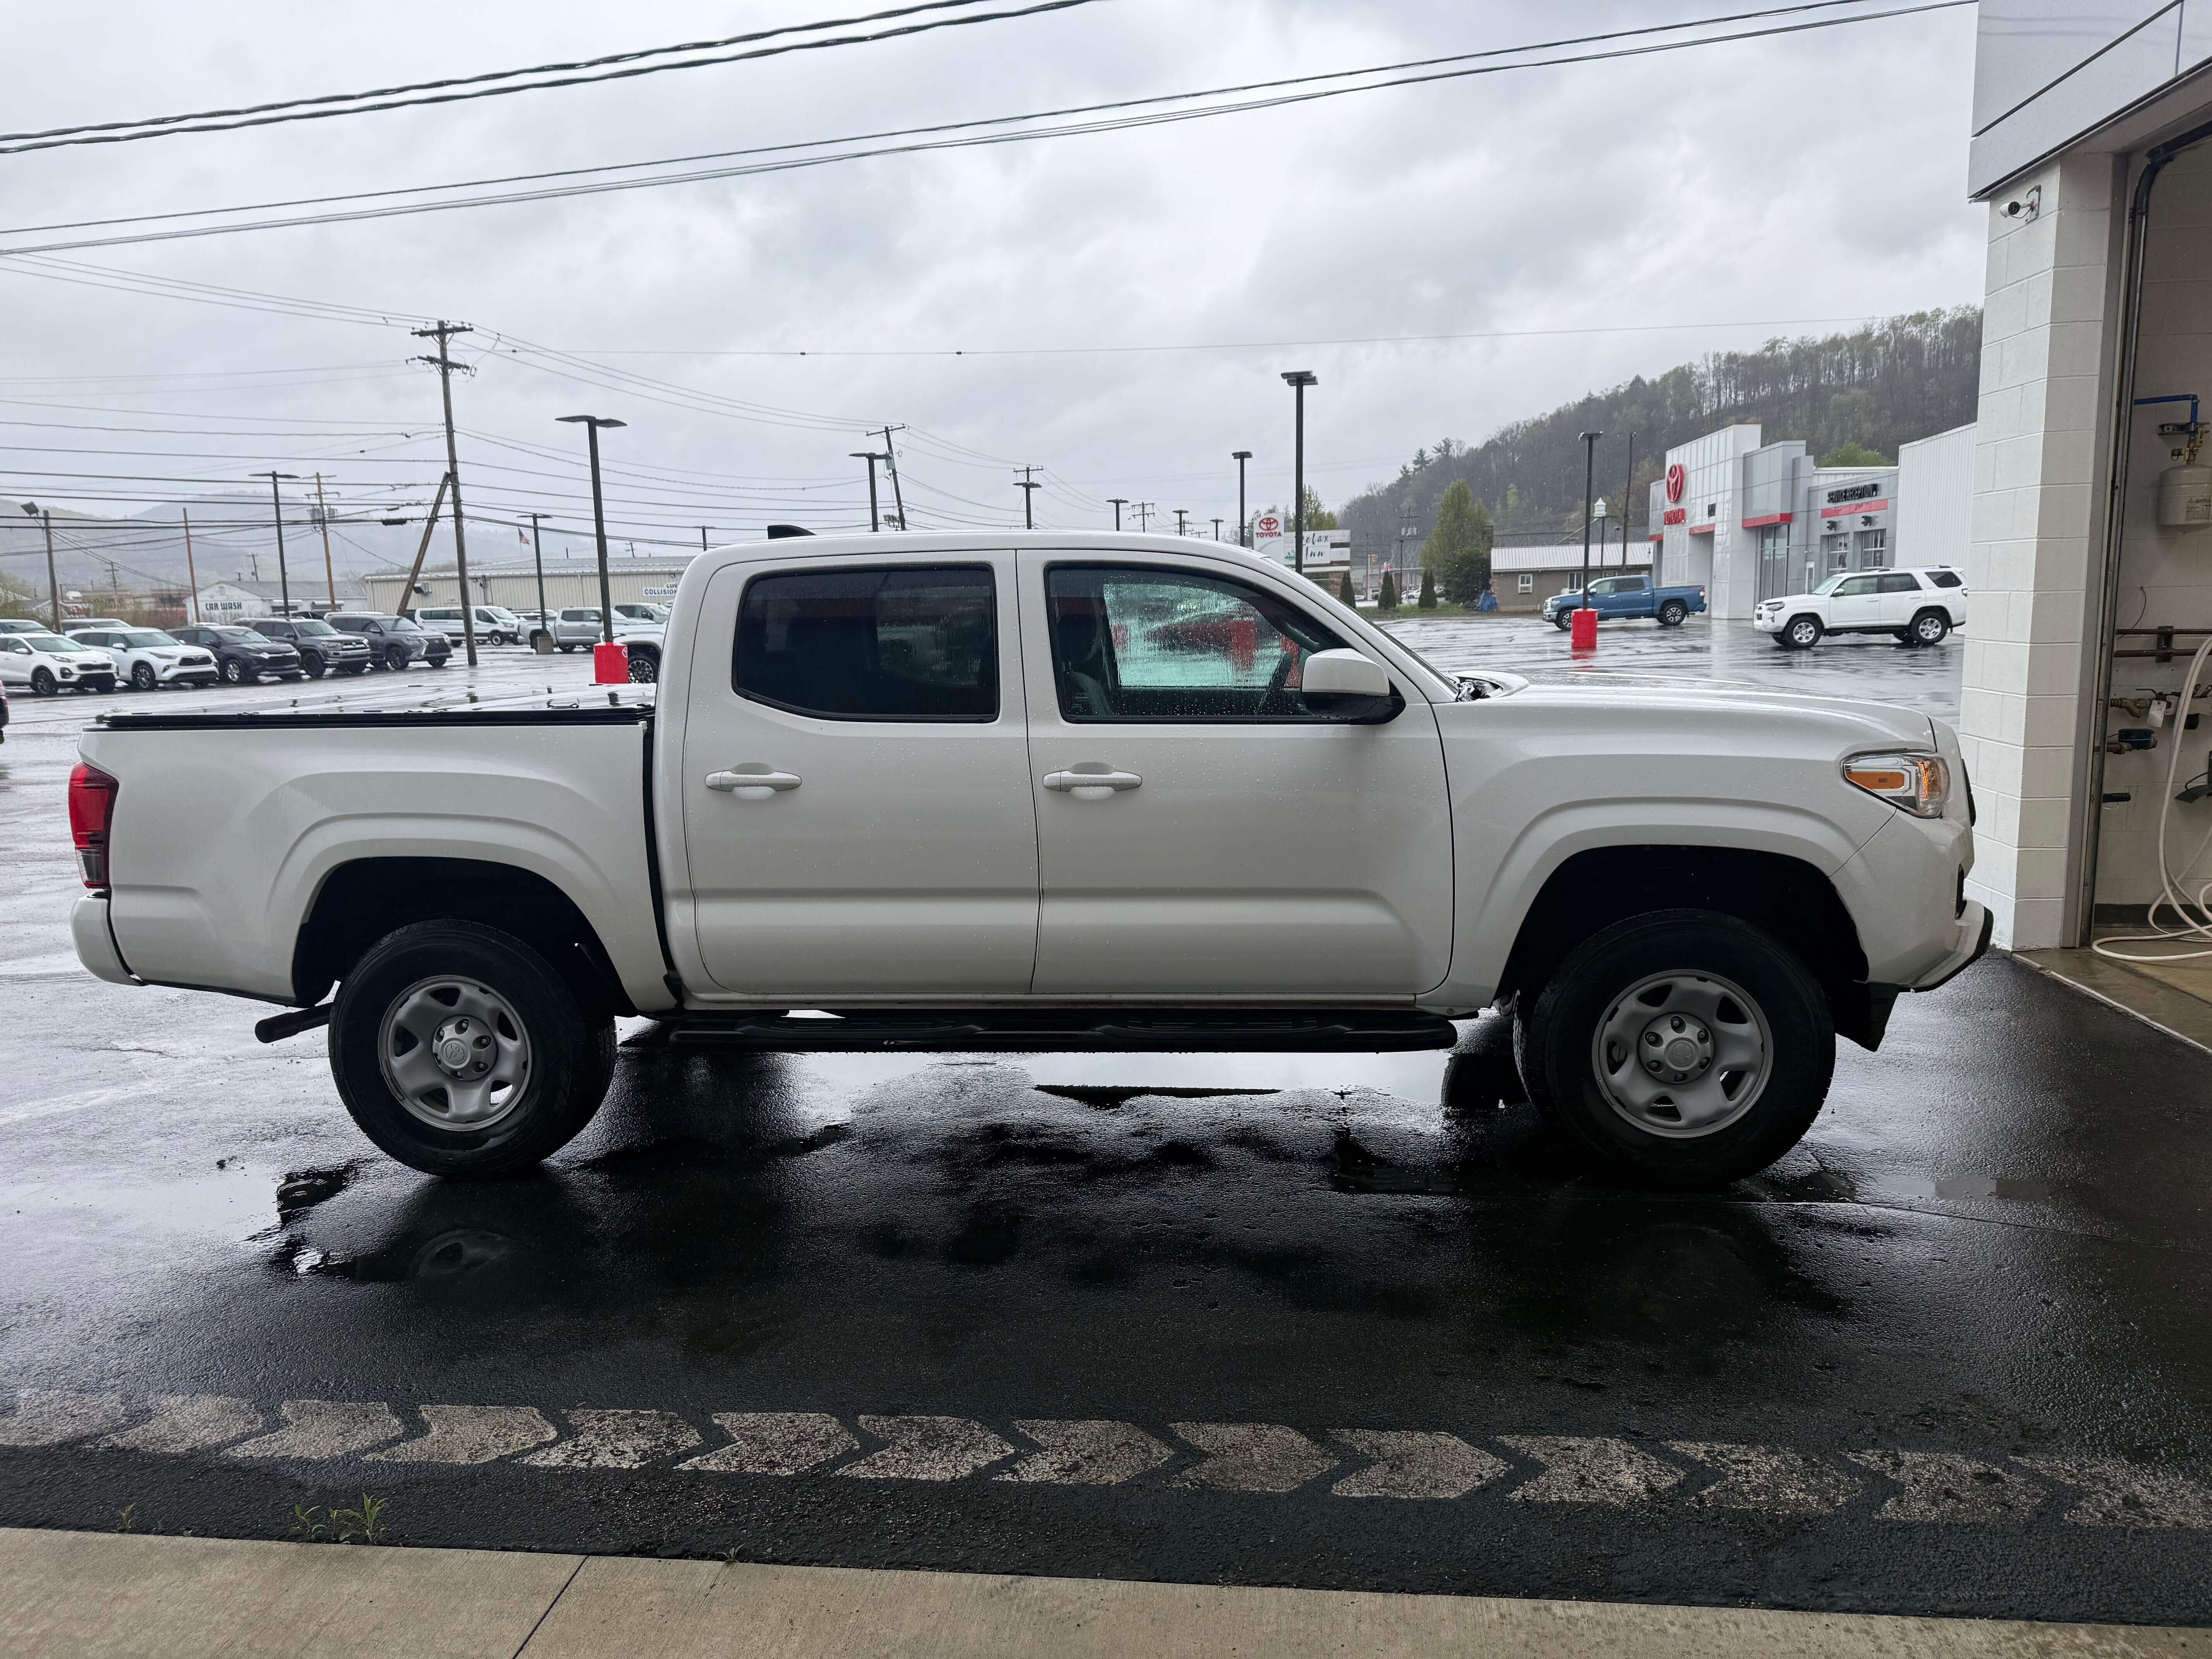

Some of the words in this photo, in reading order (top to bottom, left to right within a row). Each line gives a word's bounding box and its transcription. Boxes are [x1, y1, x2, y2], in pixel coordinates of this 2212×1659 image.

[1827, 489, 1846, 503] SERVICE
[1846, 484, 1877, 501] RECEPTION
[1664, 508, 1685, 525] TOYOTA
[1302, 532, 1328, 545] elax
[1306, 546, 1325, 560] Inn
[220, 601, 242, 610] WASH
